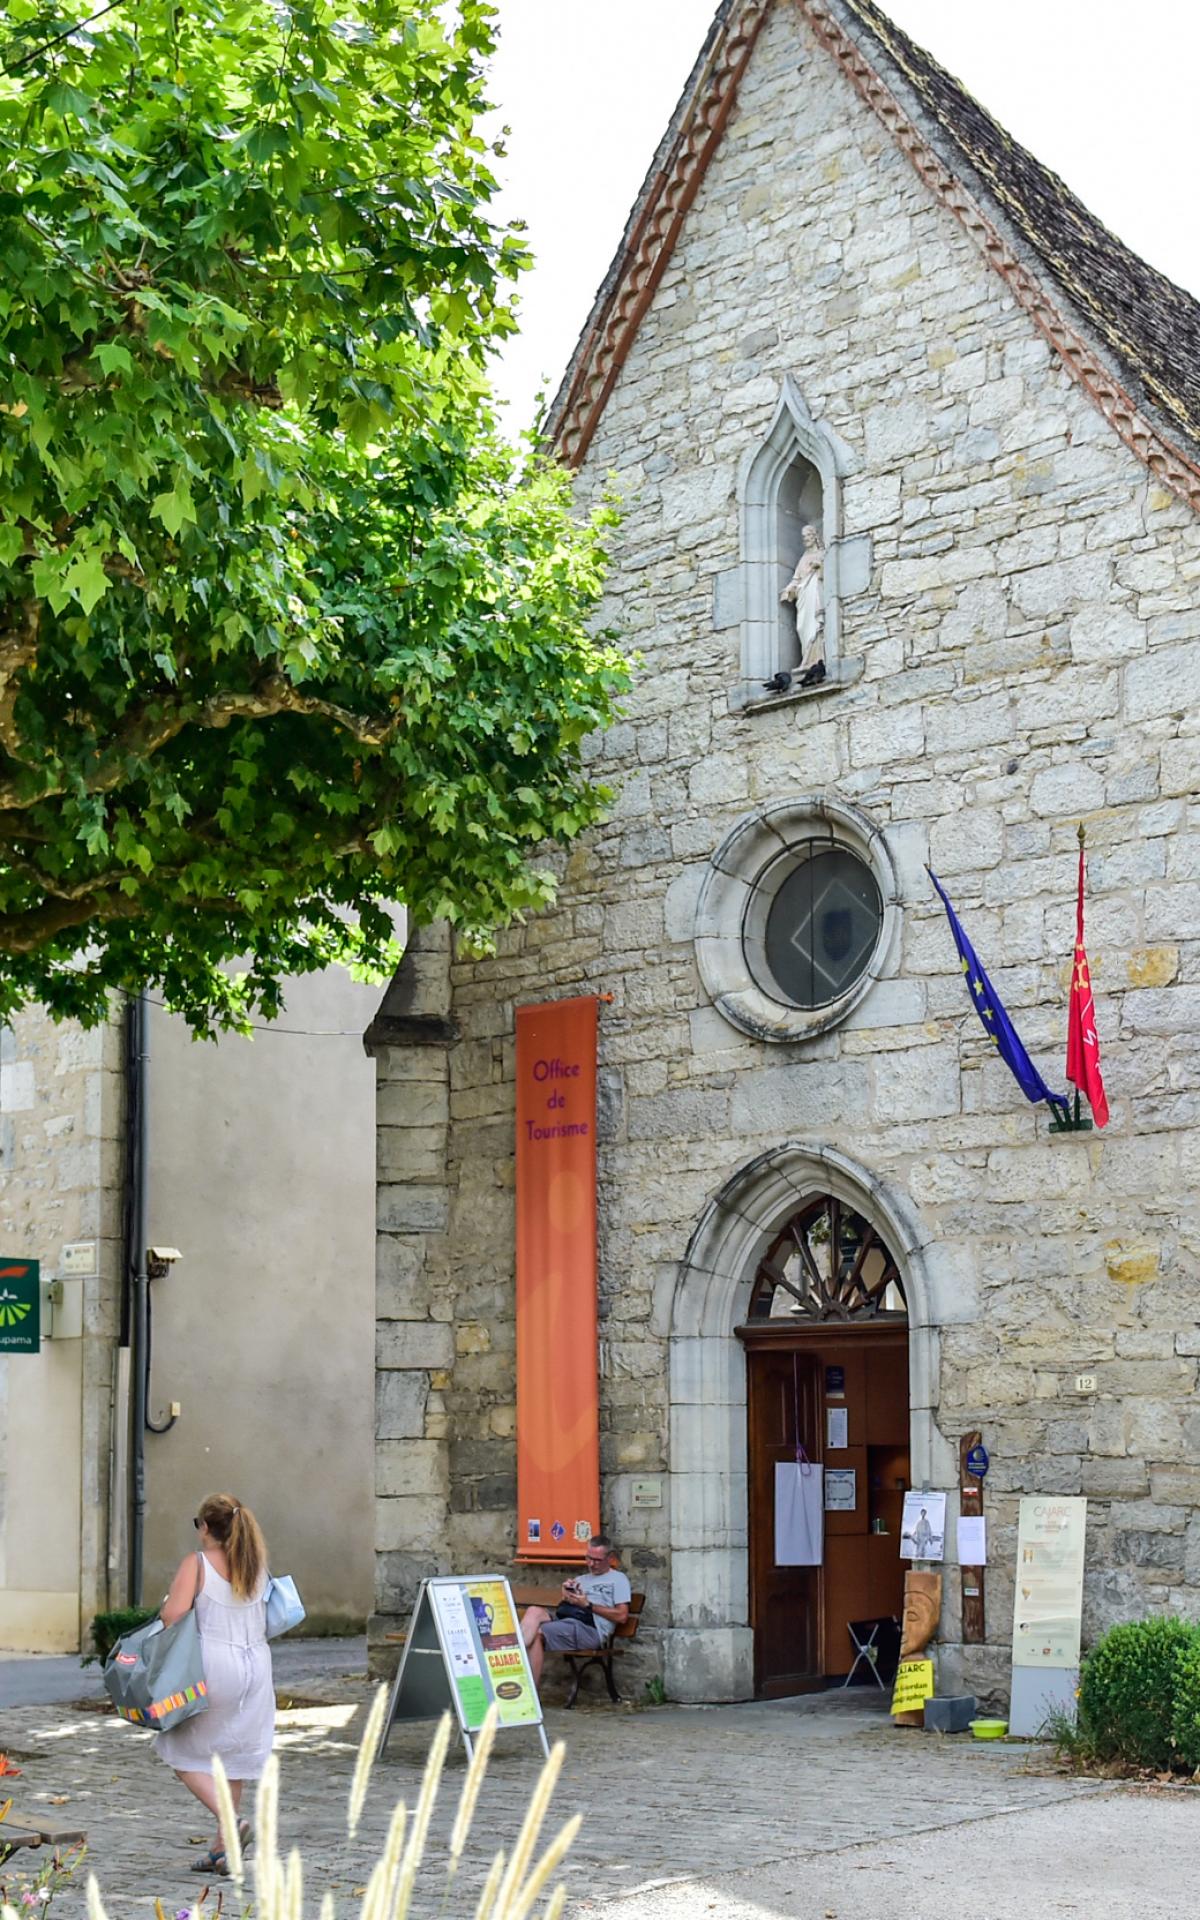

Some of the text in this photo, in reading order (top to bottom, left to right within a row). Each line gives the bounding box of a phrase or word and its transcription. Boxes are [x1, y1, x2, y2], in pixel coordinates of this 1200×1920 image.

[533, 1058, 580, 1081] Office
[547, 1088, 566, 1109] de
[525, 1119, 588, 1140] Tourisme
[1080, 1379, 1092, 1388] 12
[1033, 1505, 1072, 1518] CAJARC
[488, 1653, 521, 1667] CAJARC
